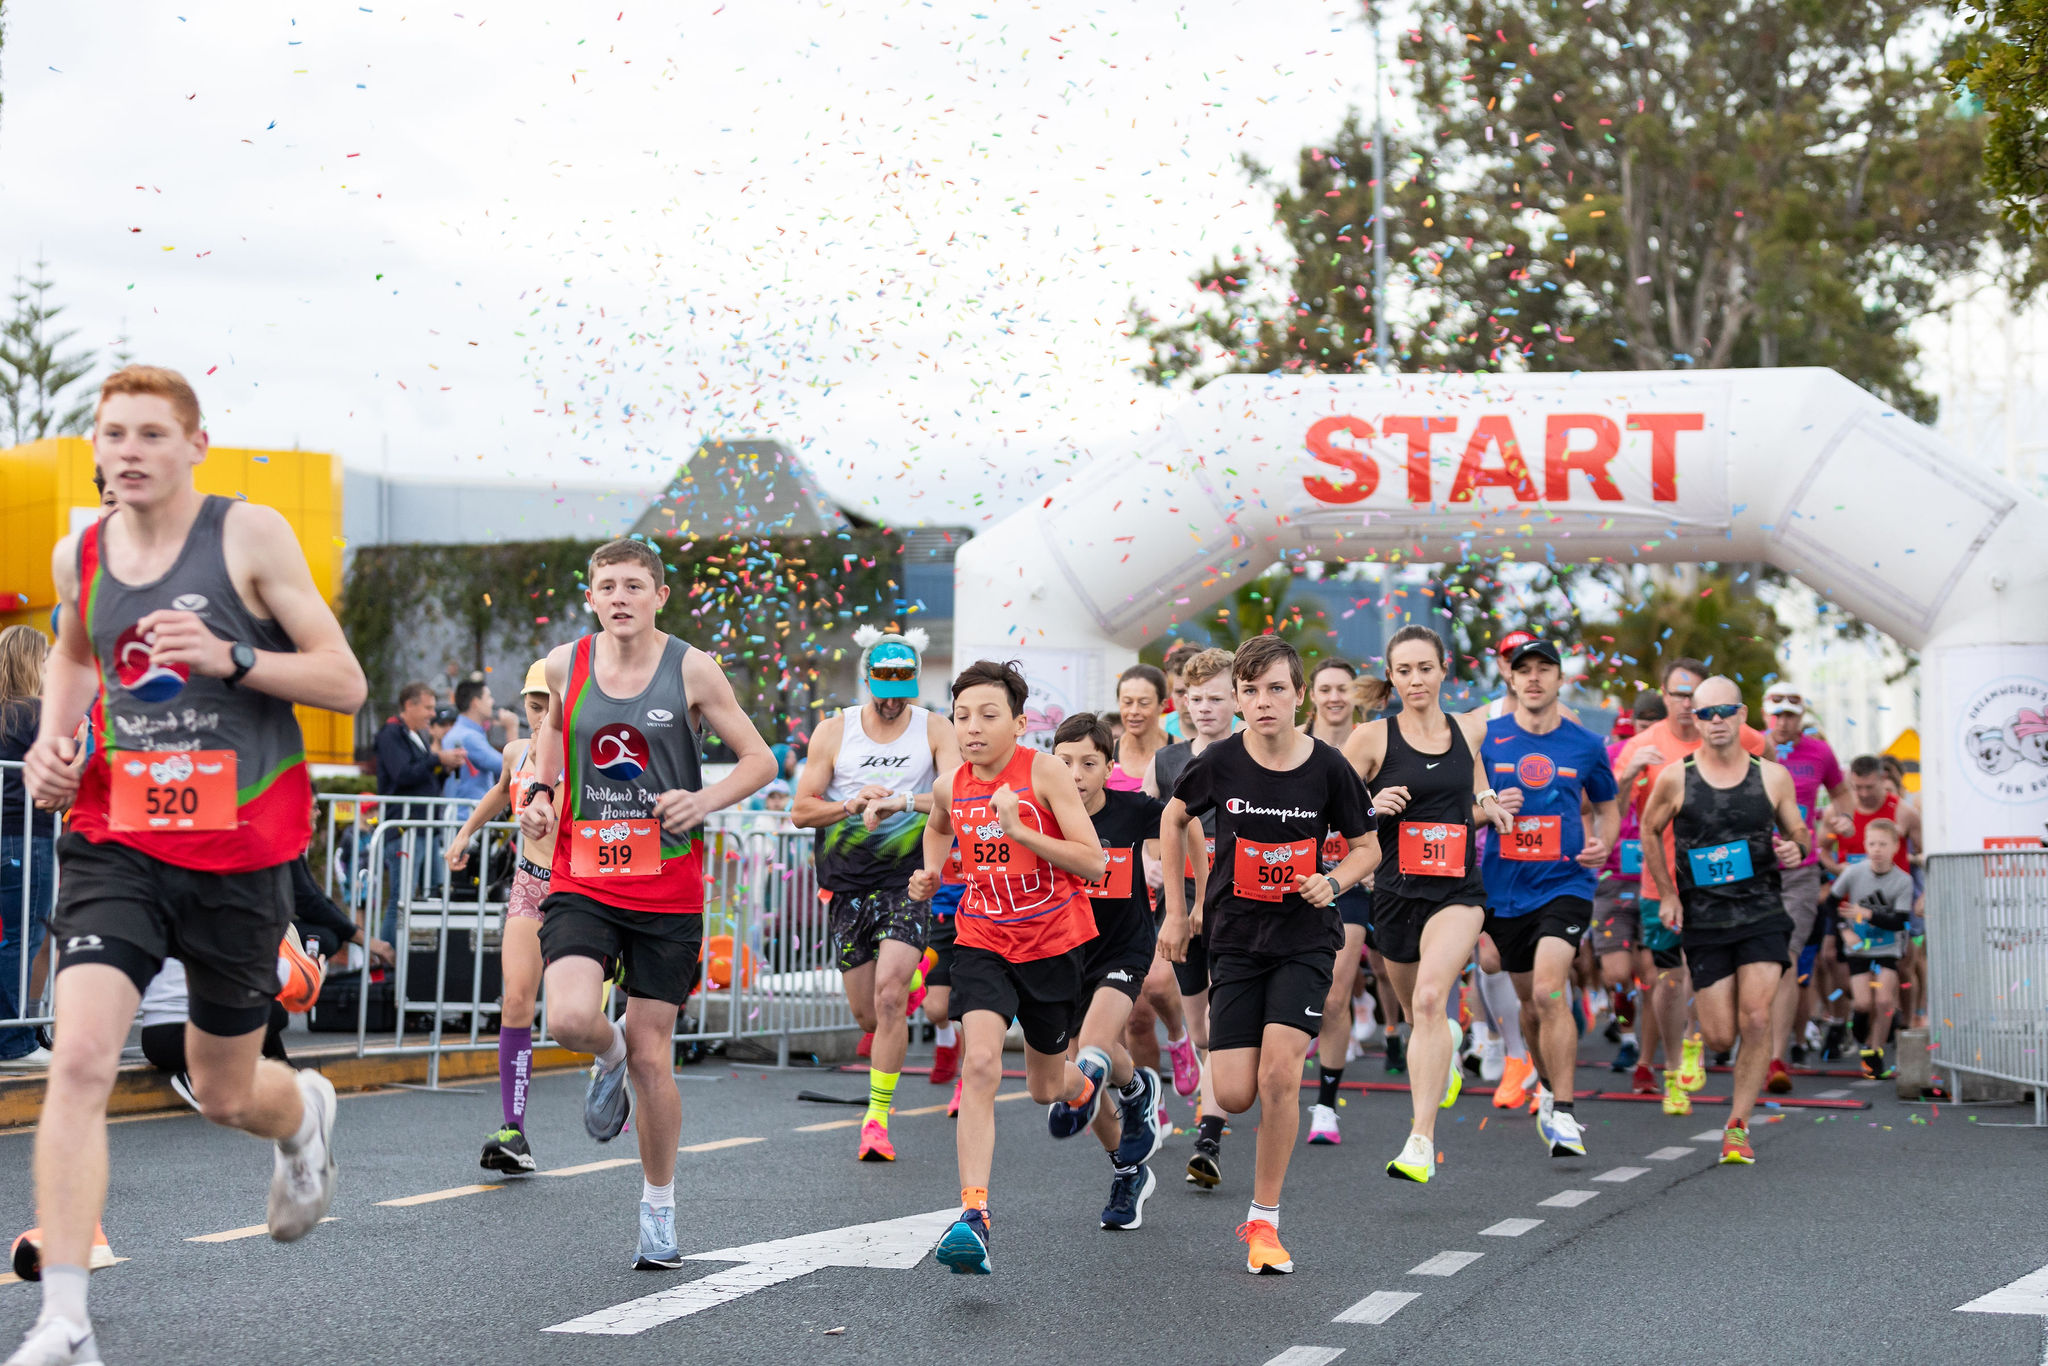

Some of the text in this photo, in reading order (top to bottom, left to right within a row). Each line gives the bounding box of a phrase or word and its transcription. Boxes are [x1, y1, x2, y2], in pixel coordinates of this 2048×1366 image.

[1303, 413, 1704, 503] START
[146, 787, 198, 814] 520
[585, 785, 632, 801] Redland
[600, 803, 648, 820] Homers
[1226, 798, 1316, 823] Champion
[1515, 833, 1543, 847] 504
[598, 845, 632, 865] 519
[974, 843, 1010, 863] 528
[1423, 843, 1445, 859] 511
[1258, 866, 1294, 884] 502
[1708, 861, 1734, 877] 572
